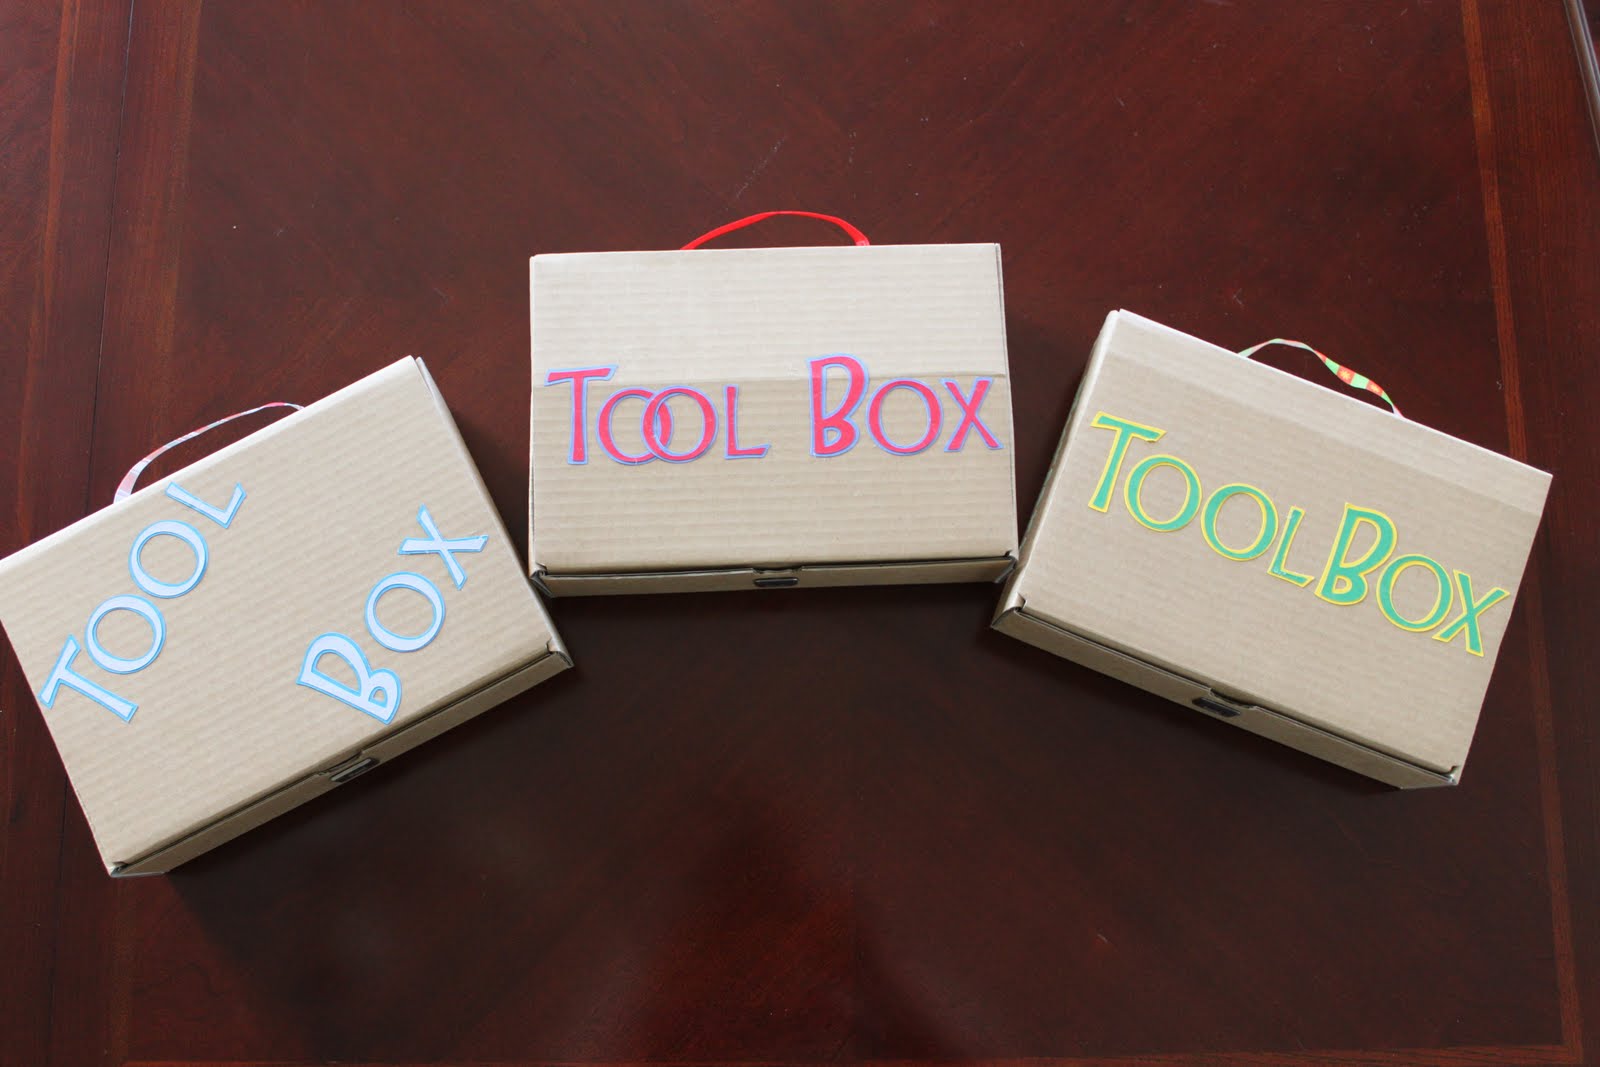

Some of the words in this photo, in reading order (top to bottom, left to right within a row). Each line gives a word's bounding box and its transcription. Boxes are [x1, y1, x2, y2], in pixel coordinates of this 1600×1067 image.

[545, 364, 771, 466] TOOL
[806, 353, 1004, 458] BOX
[38, 481, 248, 724] TOOL
[295, 504, 490, 726] BOX
